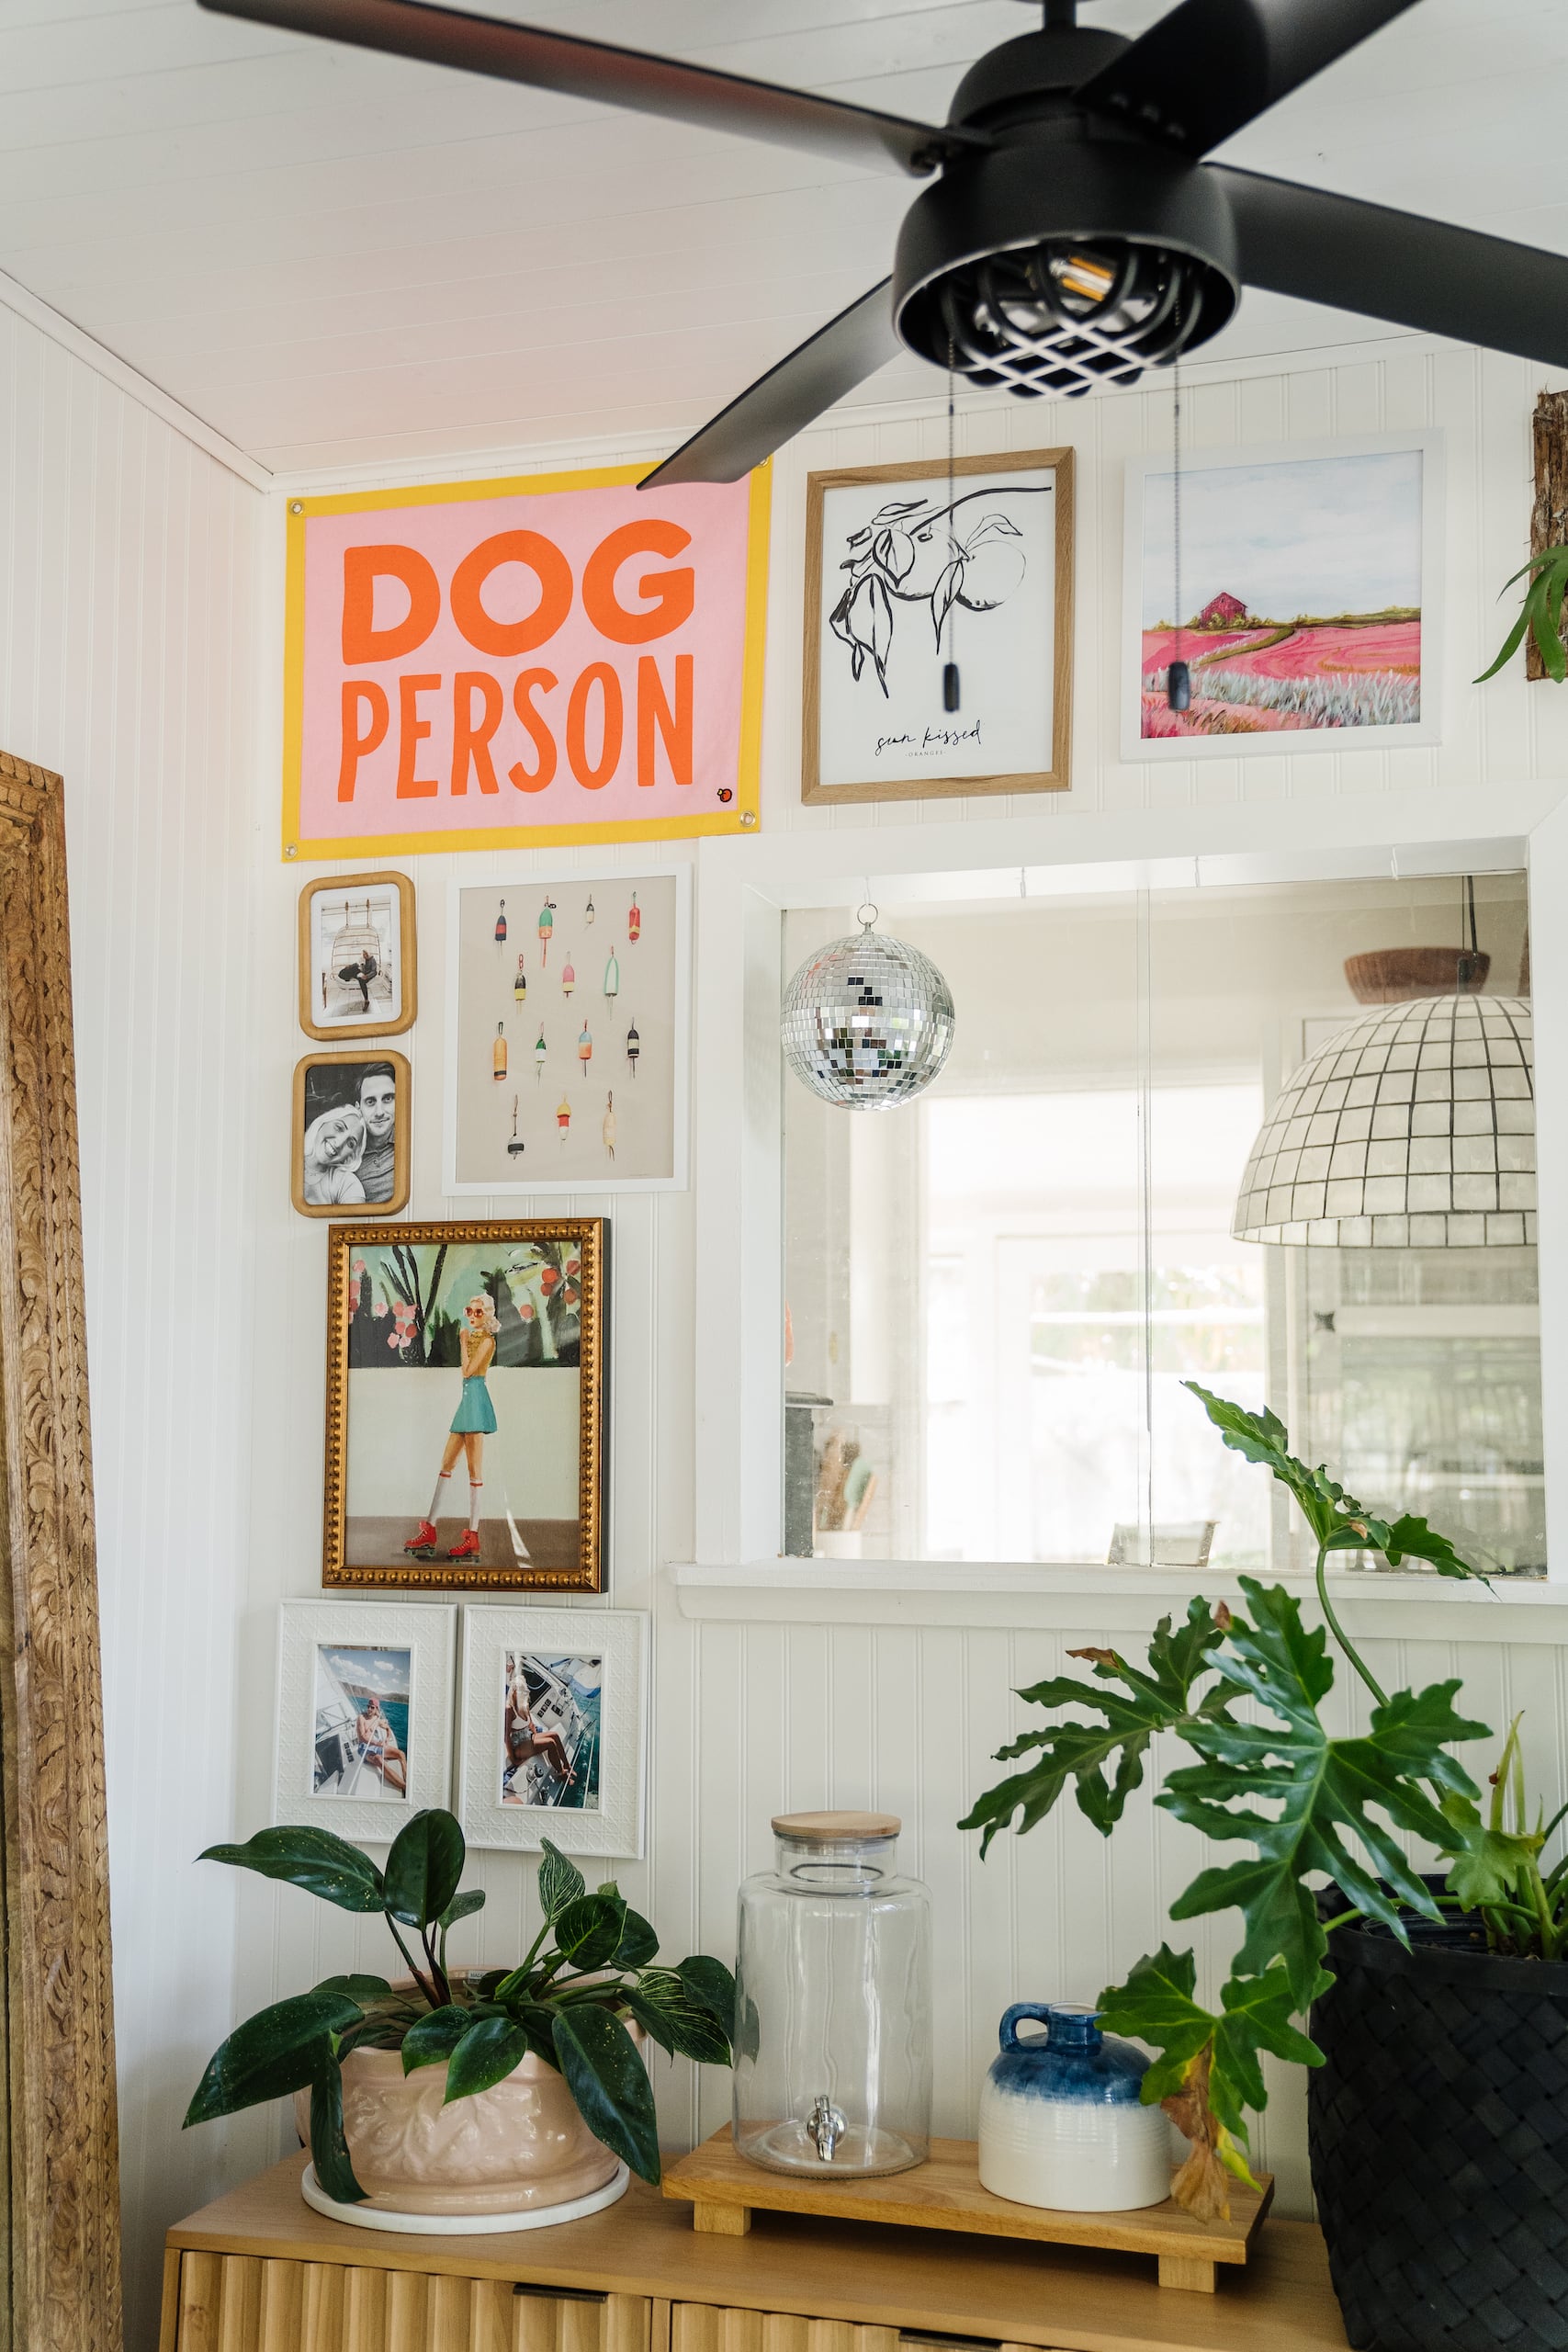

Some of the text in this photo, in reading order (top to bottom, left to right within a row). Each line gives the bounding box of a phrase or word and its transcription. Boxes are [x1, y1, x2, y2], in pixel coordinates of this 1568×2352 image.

[342, 519, 695, 666] DOG
[337, 654, 694, 803] PERSON
[874, 719, 982, 757] sun kissed
